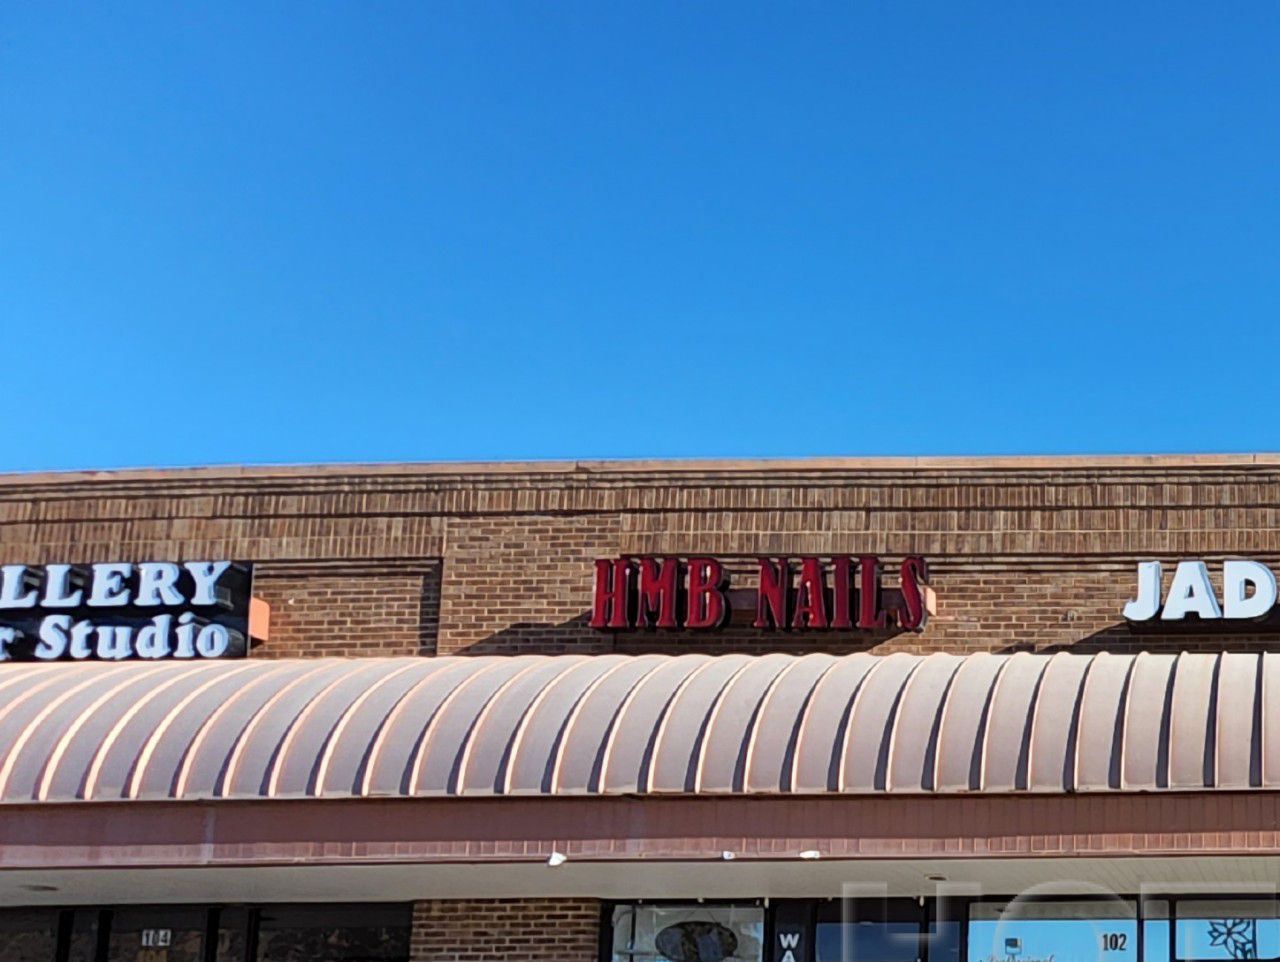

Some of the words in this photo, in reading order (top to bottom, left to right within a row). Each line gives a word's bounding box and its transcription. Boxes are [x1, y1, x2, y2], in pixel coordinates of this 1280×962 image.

[0, 560, 232, 609] LLERY
[588, 557, 728, 630] HMB
[752, 556, 930, 633] NAILS
[34, 611, 231, 660] Studio
[142, 929, 171, 946] 104
[1102, 933, 1128, 951] 102
